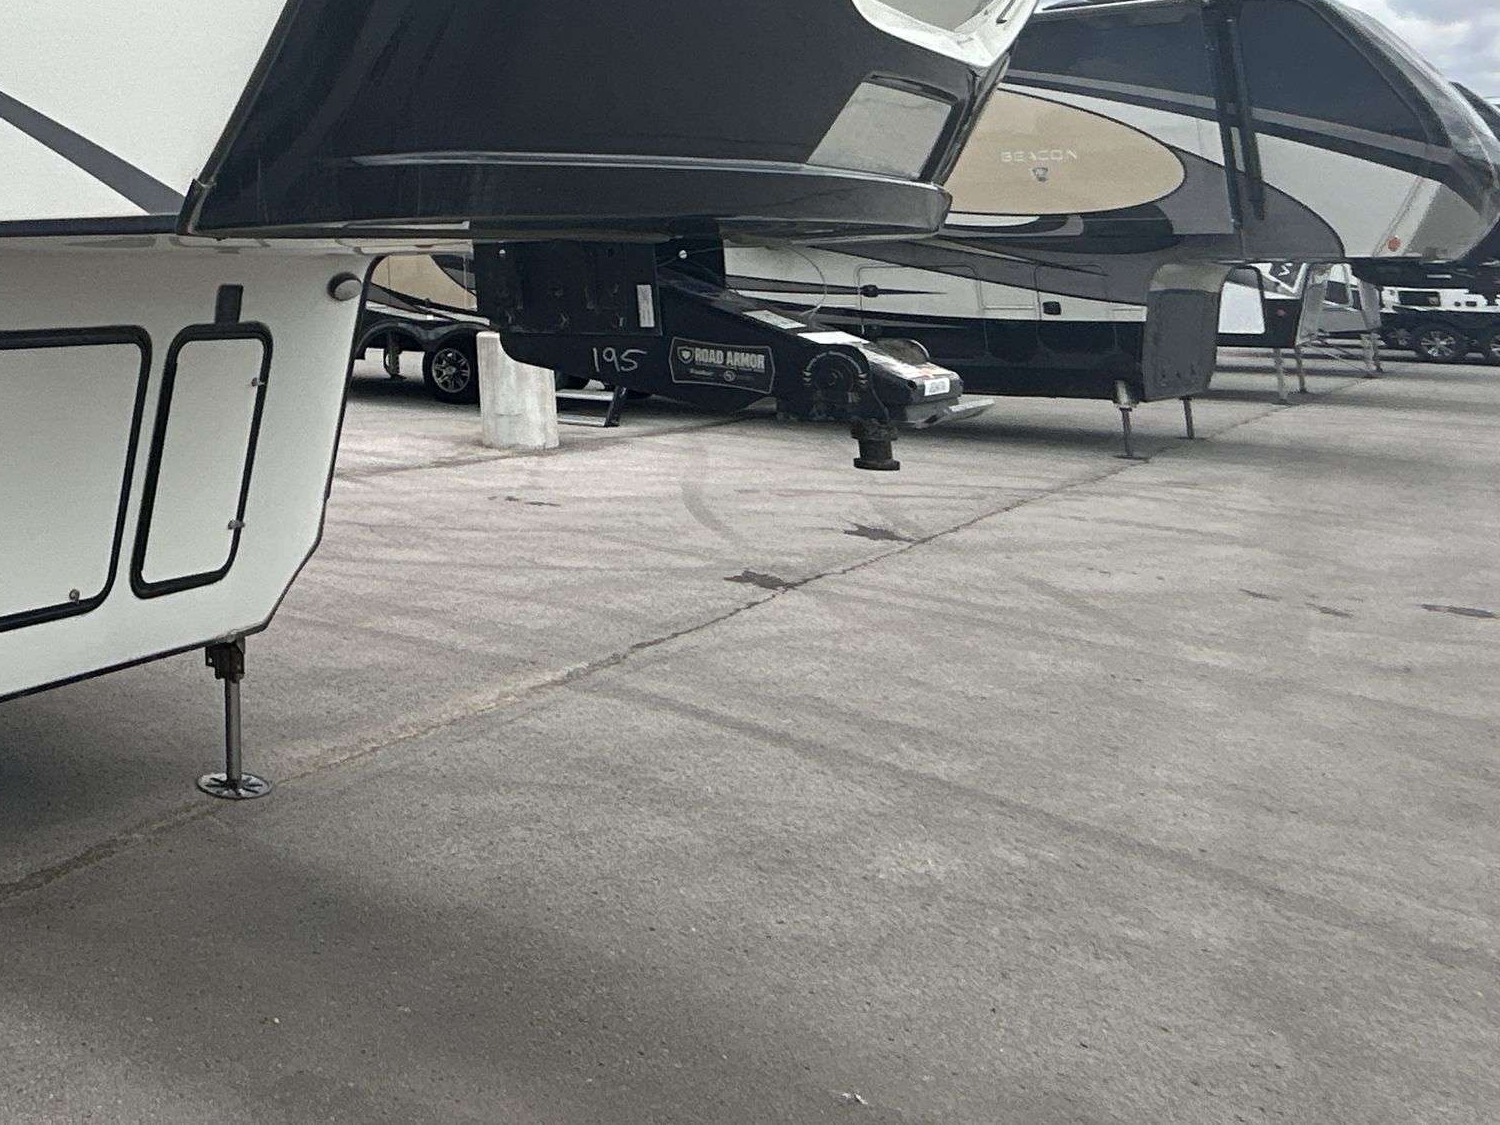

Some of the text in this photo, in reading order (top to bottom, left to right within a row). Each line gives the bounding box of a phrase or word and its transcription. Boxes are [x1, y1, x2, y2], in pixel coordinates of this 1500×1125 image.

[592, 347, 647, 372] 195
[694, 347, 765, 370] ROAD ARMOR
